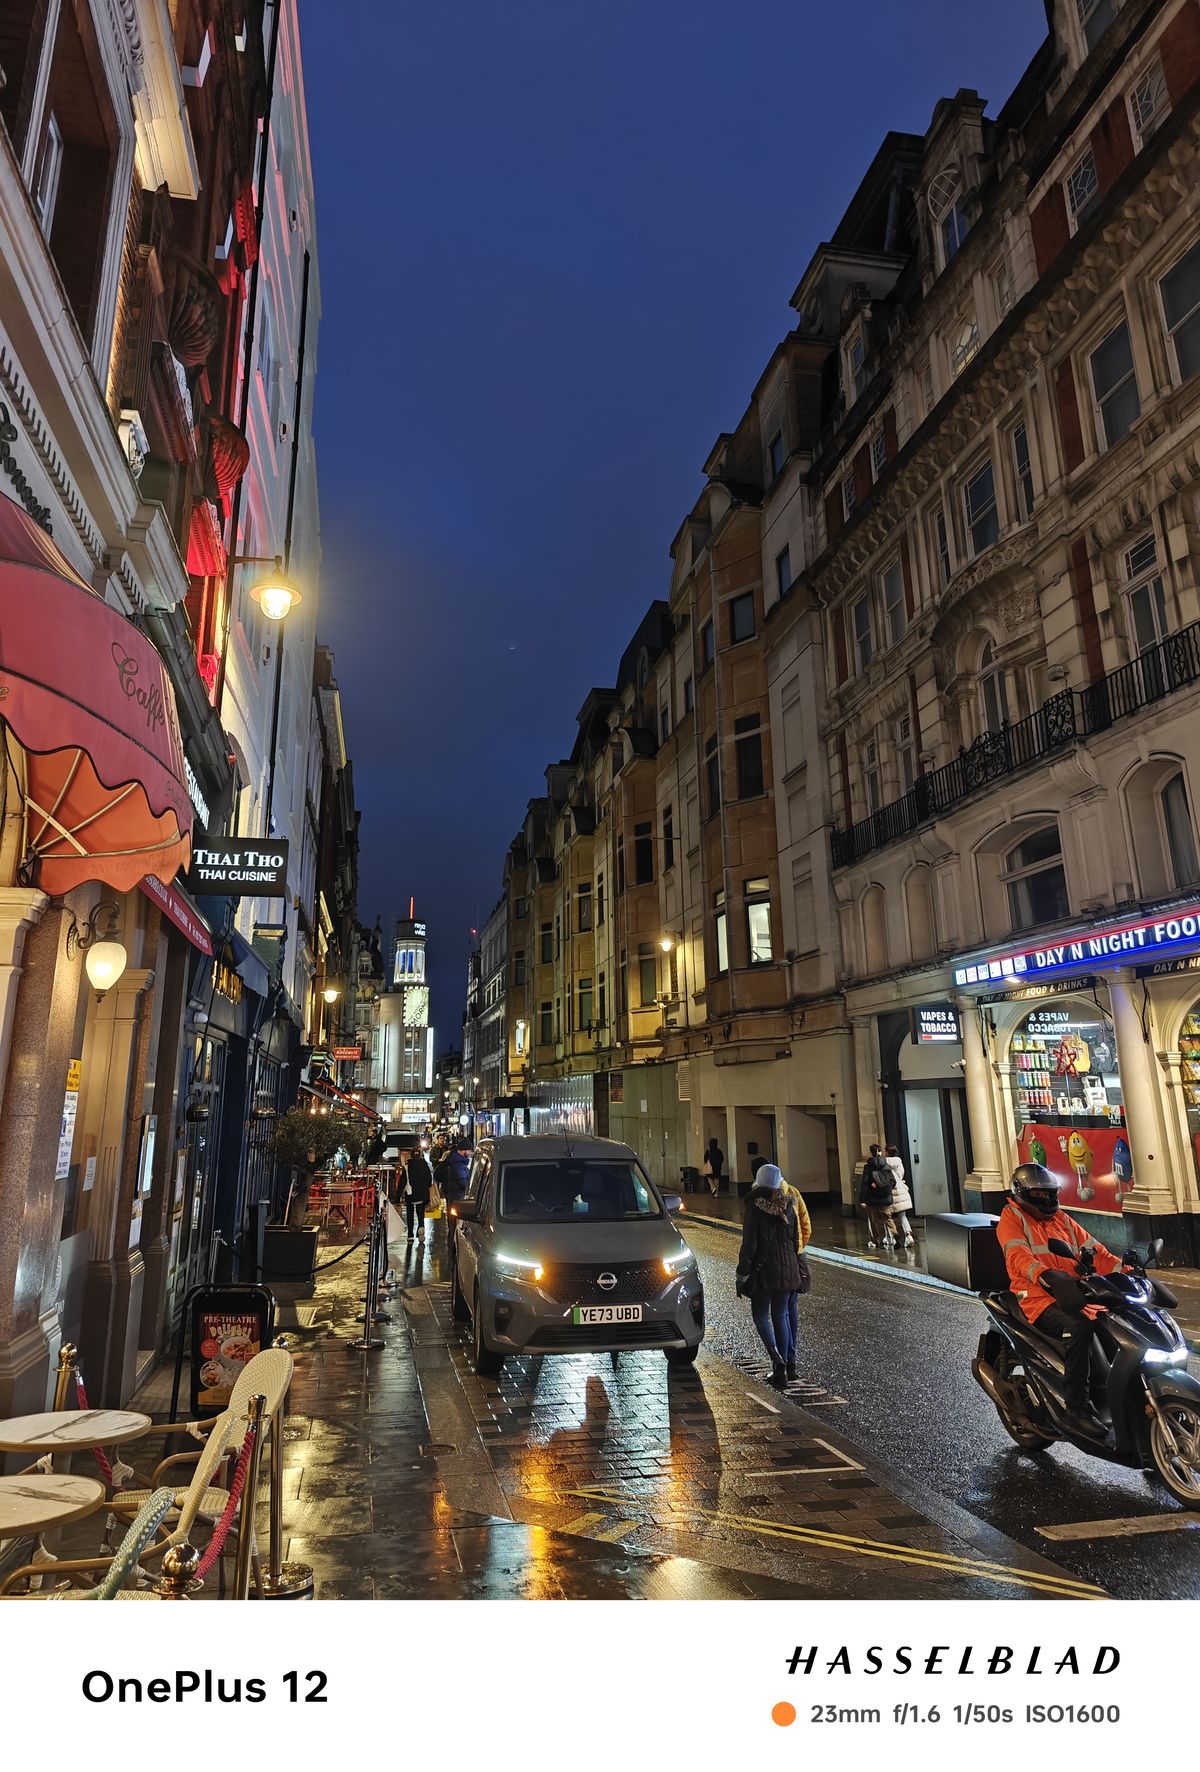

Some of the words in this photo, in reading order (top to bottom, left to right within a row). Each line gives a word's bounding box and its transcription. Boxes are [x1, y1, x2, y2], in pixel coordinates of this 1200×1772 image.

[193, 849, 241, 866] THAI
[244, 852, 284, 867] THO
[198, 869, 226, 880] THAI
[228, 870, 277, 882] CUISINE
[1035, 946, 1065, 968] DAY
[1071, 942, 1083, 960] N
[1089, 928, 1146, 957] NIGHT
[1154, 915, 1200, 942] FOO
[1153, 961, 1173, 974] DAY
[1176, 960, 1186, 970] N
[1026, 986, 1047, 996] FOOD
[1049, 984, 1055, 993] &
[1057, 978, 1088, 992] DRINKS
[921, 1011, 946, 1021] VAPES
[948, 1012, 954, 1021] &
[920, 1022, 957, 1032] TOBACCO
[204, 1316, 257, 1324] PRE-THEATRE
[581, 1309, 613, 1322] YE73
[616, 1307, 640, 1320] UBD
